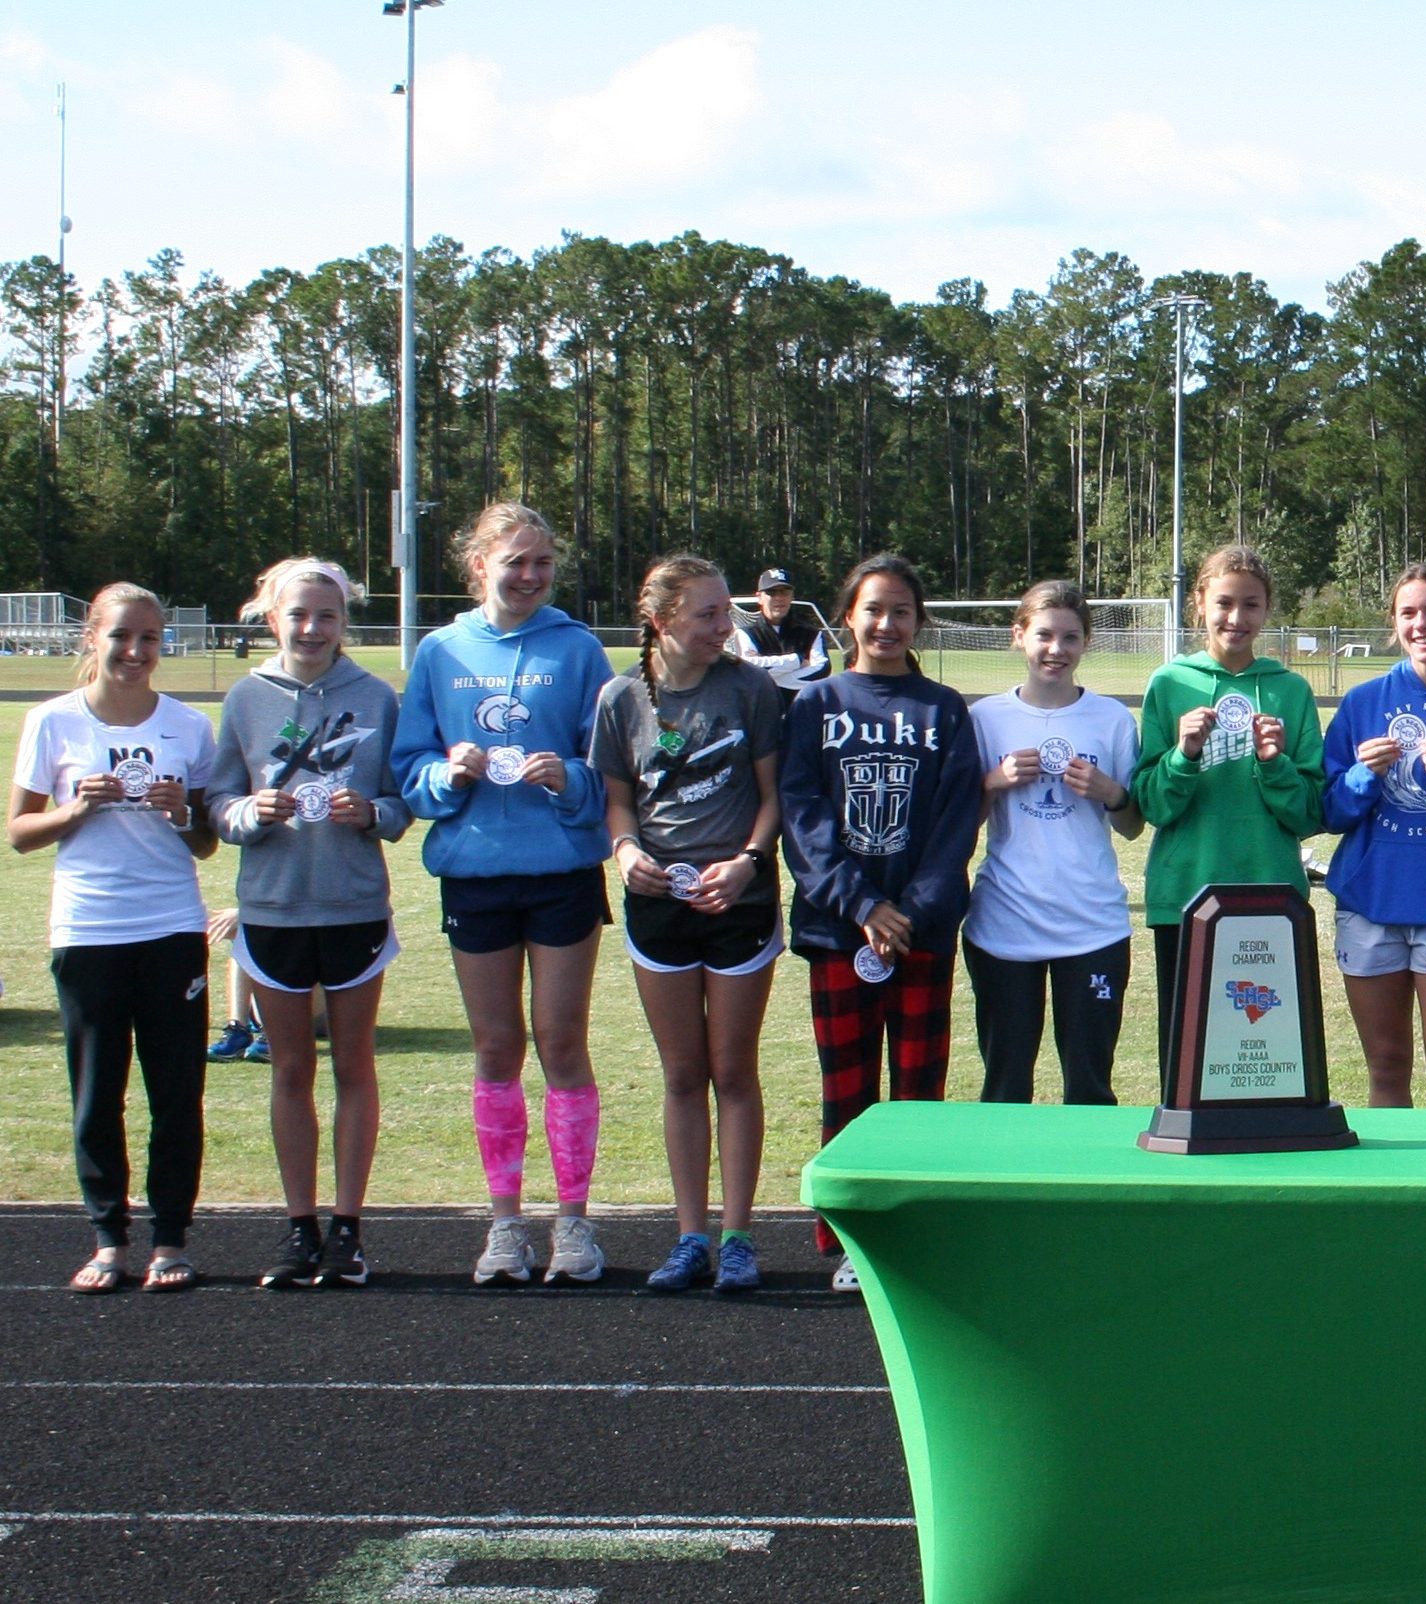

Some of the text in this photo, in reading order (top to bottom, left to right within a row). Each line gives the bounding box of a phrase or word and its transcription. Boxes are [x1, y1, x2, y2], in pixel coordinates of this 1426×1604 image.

[453, 676, 507, 689] HILTON
[1228, 699, 1249, 715] REGION
[1384, 703, 1411, 720] MAY
[822, 710, 939, 751] Duke
[1376, 813, 1399, 833] IGH
[1239, 940, 1269, 952] REGION
[1232, 953, 1276, 965] CHAMPION
[1240, 1039, 1267, 1049] REGION
[1209, 1062, 1297, 1075] BOYS CROSS COUNTRY
[1230, 1075, 1276, 1087] 2021-2022
